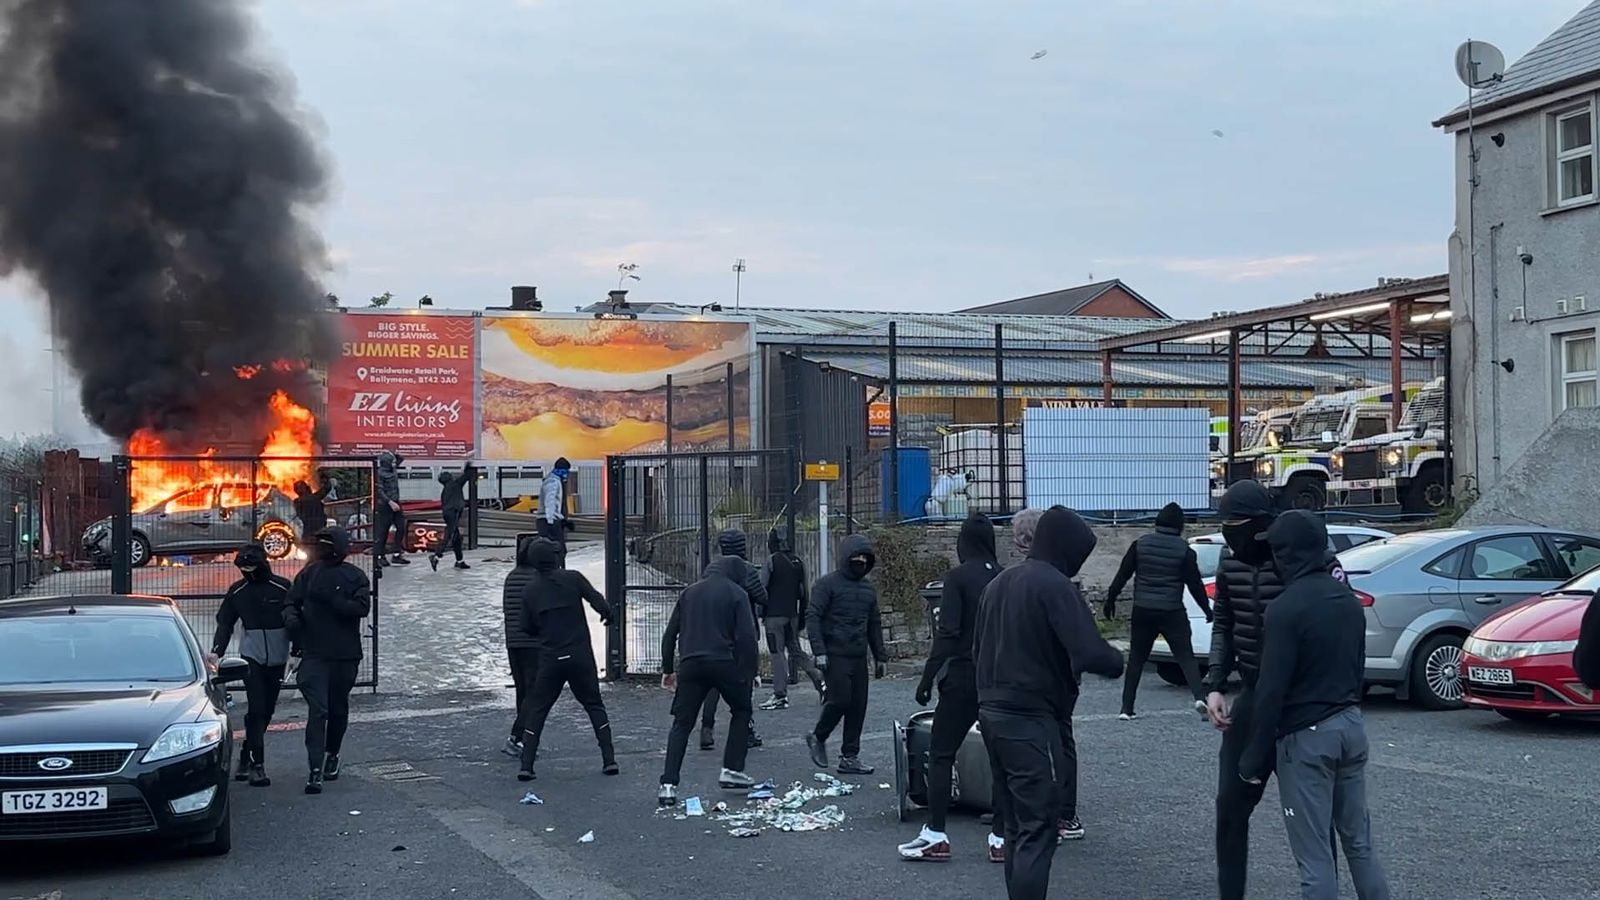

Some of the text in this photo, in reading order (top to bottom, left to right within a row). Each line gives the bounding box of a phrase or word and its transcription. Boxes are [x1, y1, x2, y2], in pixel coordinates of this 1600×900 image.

[378, 322, 430, 332] BIG STYLE.
[367, 331, 440, 340] BIGGER SAVINGS.
[341, 342, 469, 359] SUMMER SALE
[370, 366, 459, 376] Braidwater Retail Park,
[418, 376, 438, 384] BT42
[348, 390, 462, 422] EZ living
[1074, 401, 1114, 410] VALE
[357, 415, 446, 428] INTERIORS
[10, 790, 99, 811] TGZ 3292
